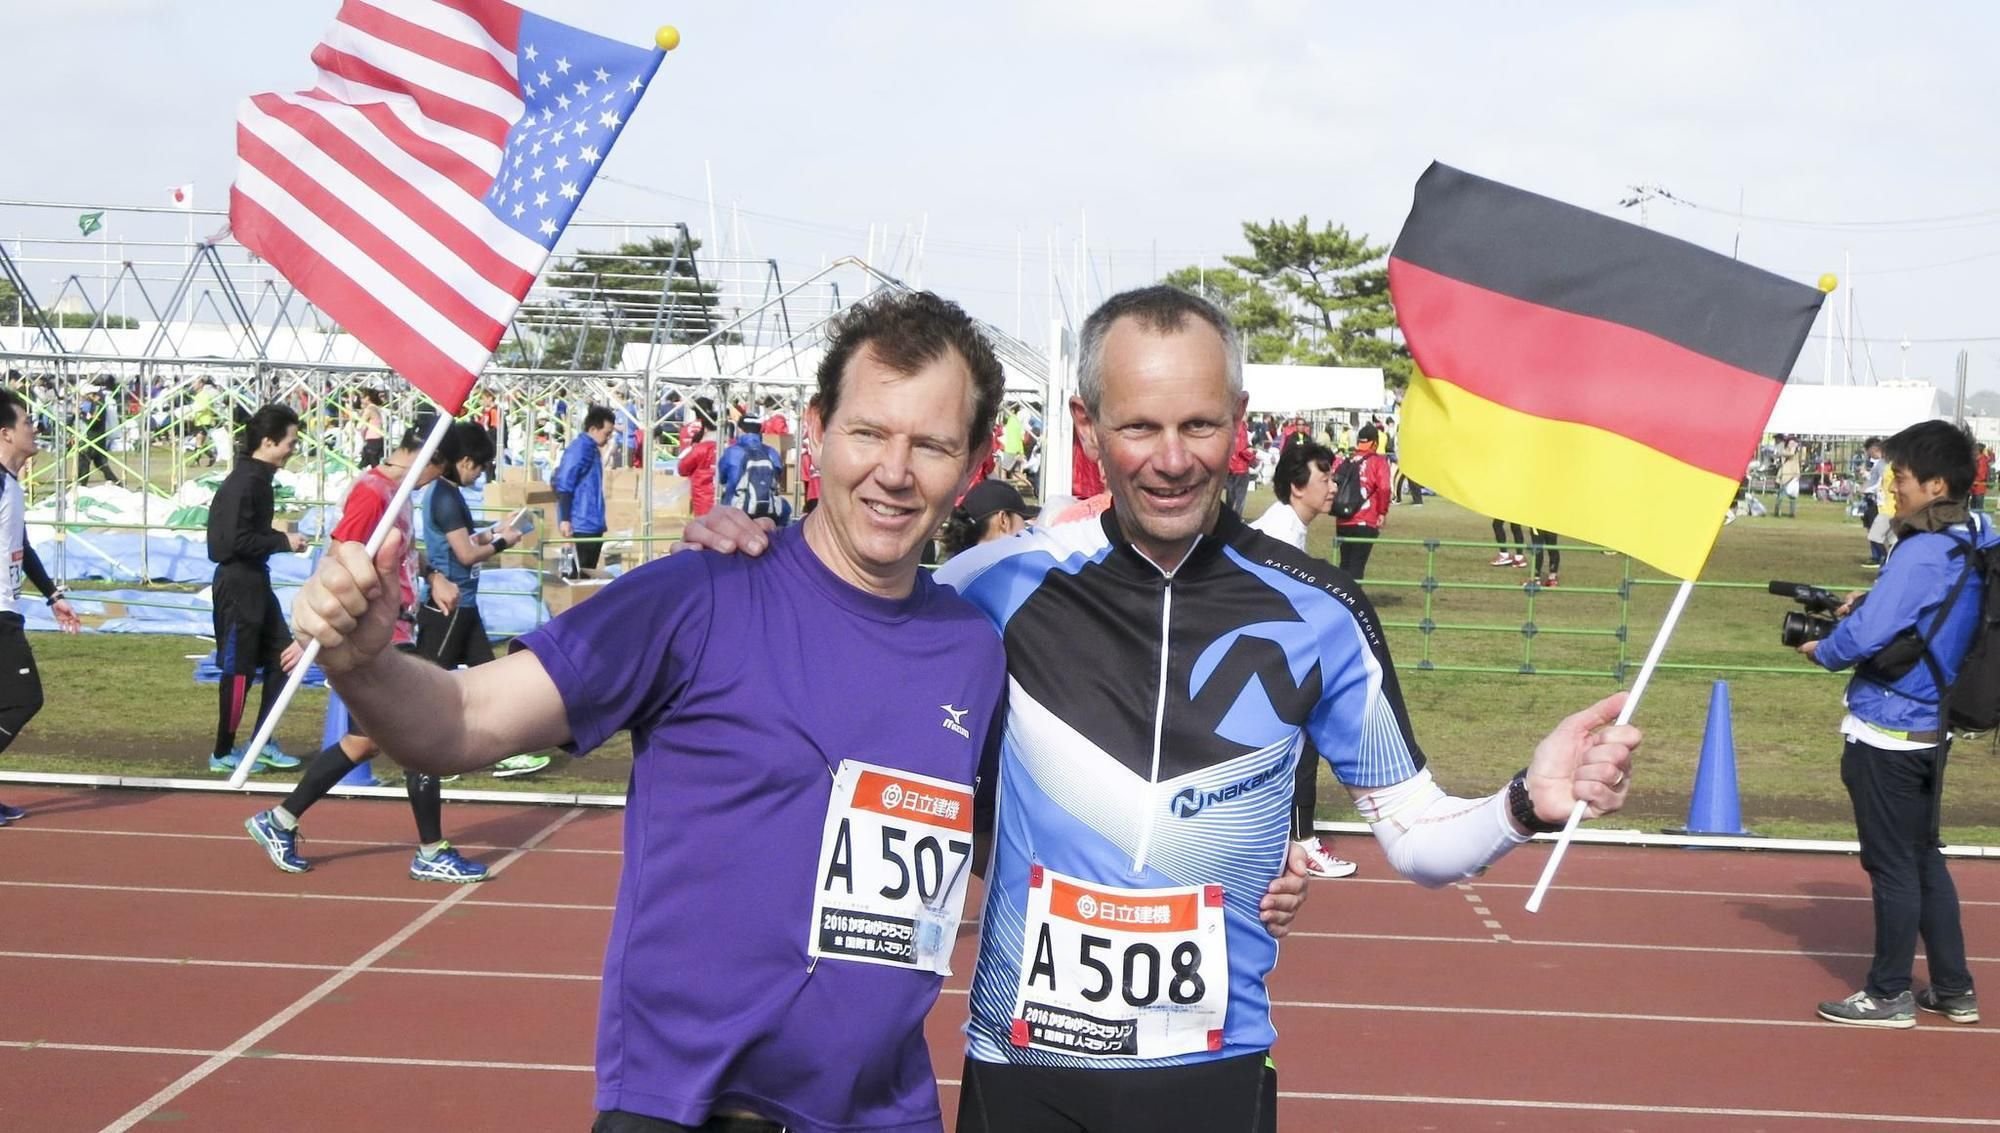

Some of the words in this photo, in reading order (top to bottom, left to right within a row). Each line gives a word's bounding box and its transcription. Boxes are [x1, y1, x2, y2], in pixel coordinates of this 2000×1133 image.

[1264, 559, 1316, 583] RACING
[1325, 583, 1356, 605] TEAM
[1358, 610, 1380, 645] SPORT
[902, 791, 960, 820] 日立建機
[824, 817, 853, 894] A
[879, 825, 971, 911] 507
[1099, 901, 1171, 924] 日立建機
[1028, 922, 1056, 991] A
[1080, 933, 1206, 1007] 508
